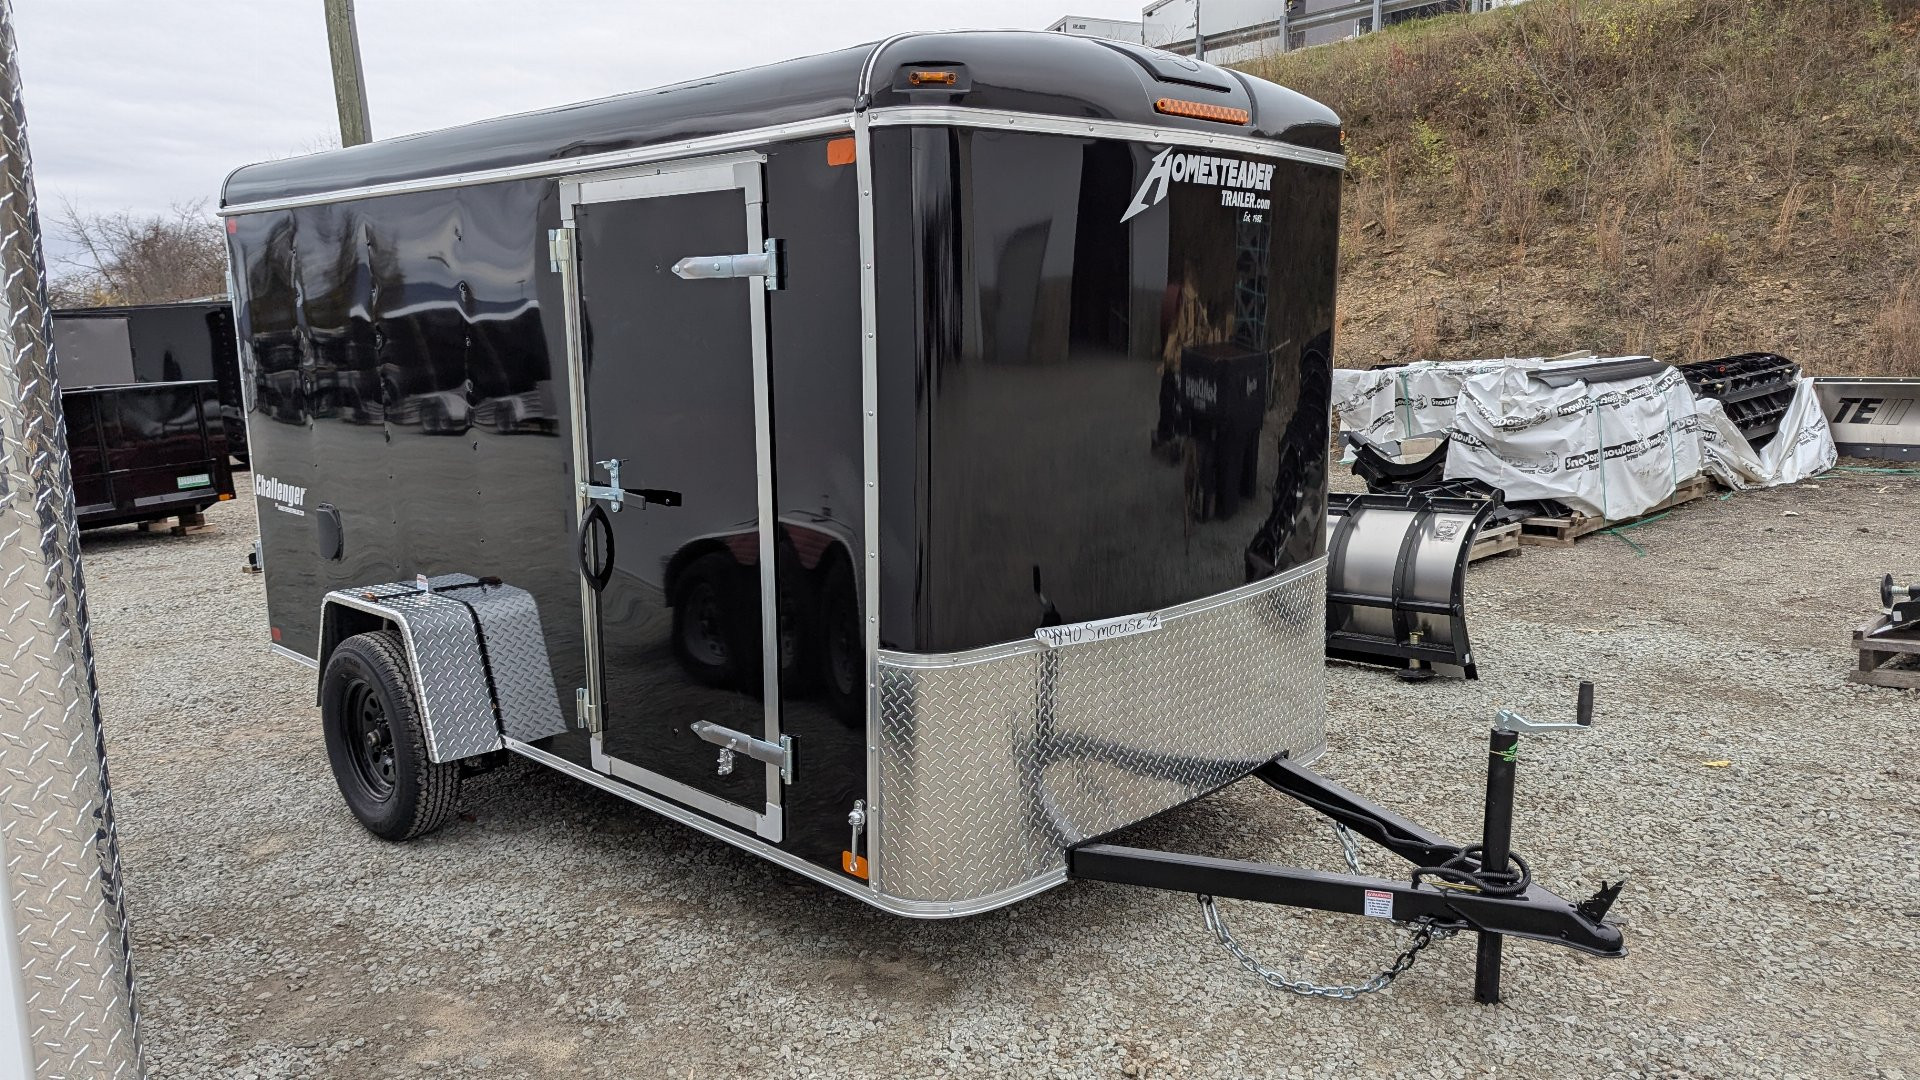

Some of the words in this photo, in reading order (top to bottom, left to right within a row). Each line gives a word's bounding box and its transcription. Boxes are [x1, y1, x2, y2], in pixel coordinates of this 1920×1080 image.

[1120, 146, 1273, 223] HOMESTEADER
[1221, 190, 1270, 209] TRAILER.com
[256, 473, 307, 507] Challenger
